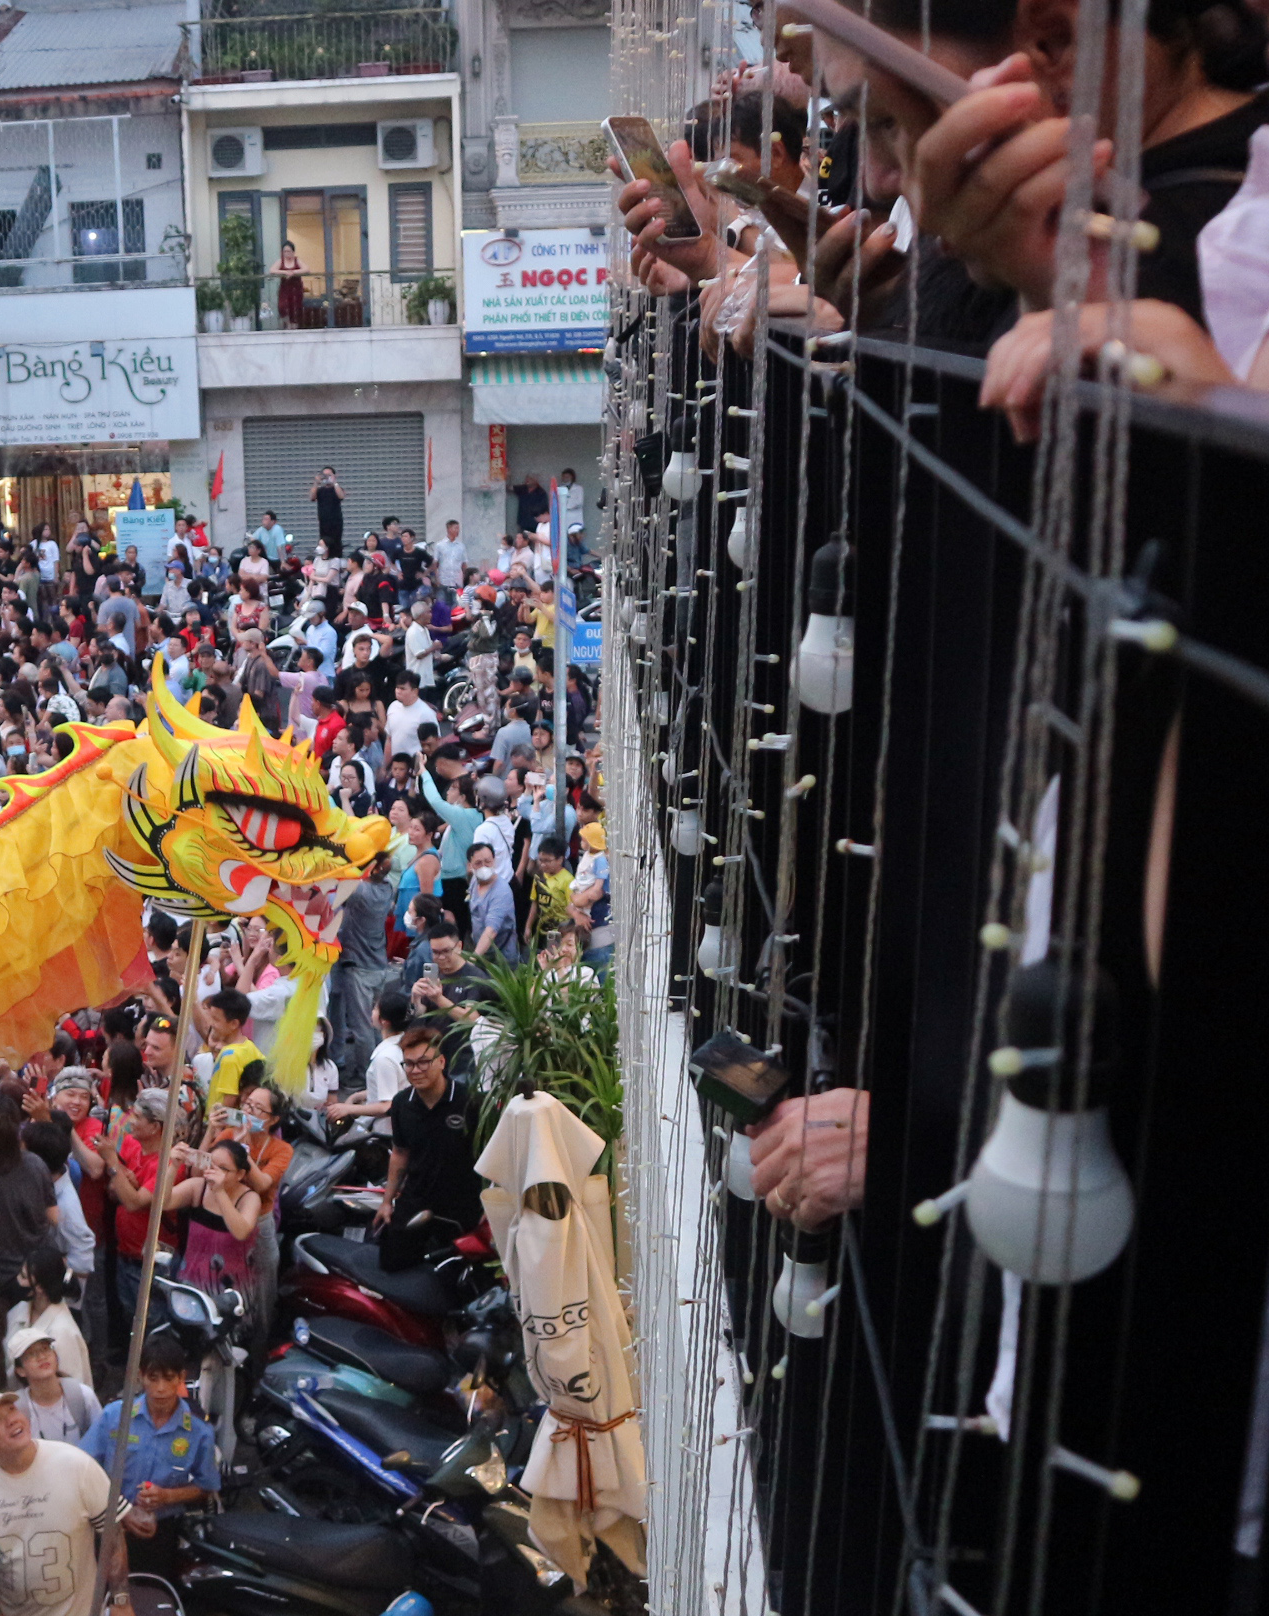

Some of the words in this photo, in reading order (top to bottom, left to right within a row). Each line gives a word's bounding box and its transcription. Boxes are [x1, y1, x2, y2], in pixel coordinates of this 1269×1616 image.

[531, 243, 557, 256] CÔNG
[559, 244, 571, 256] TY
[575, 243, 599, 255] TNHH
[521, 268, 588, 290] NGỌC
